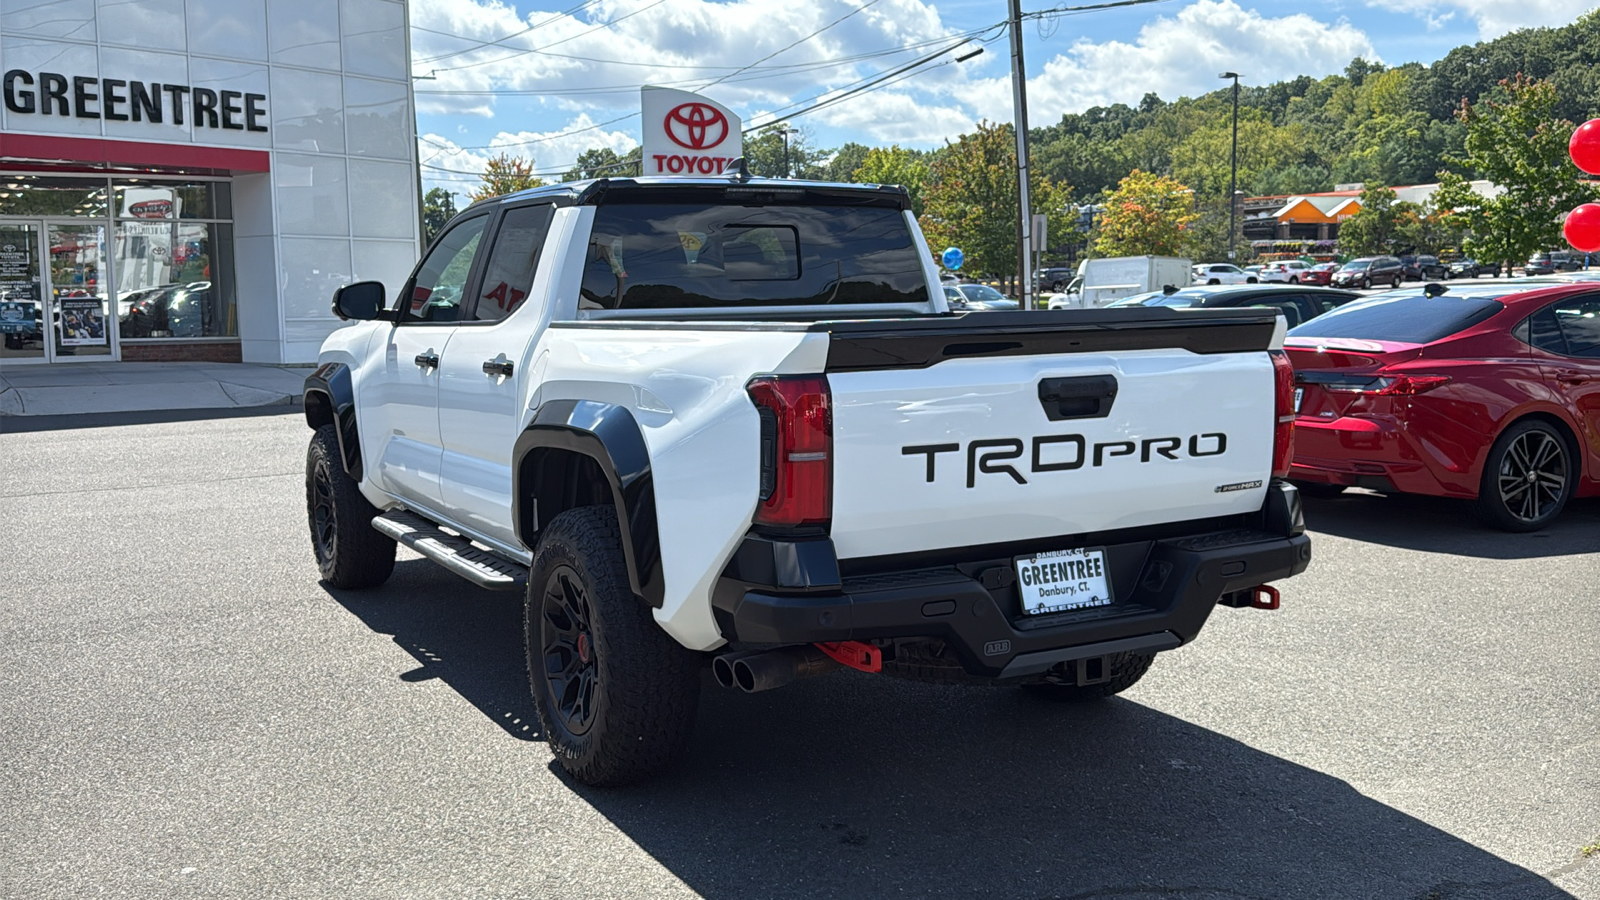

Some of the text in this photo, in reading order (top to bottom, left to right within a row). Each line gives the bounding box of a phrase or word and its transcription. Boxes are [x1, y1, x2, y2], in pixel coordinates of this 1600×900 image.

[3, 69, 268, 132] GREENTREE
[653, 155, 734, 174] TOYOT
[901, 432, 1227, 488] TRD PRO
[1021, 557, 1102, 586] GREENTREE
[1039, 581, 1090, 598] Danbury, CT.
[1029, 599, 1112, 615] GREENTREE
[987, 641, 1008, 654] ARB
